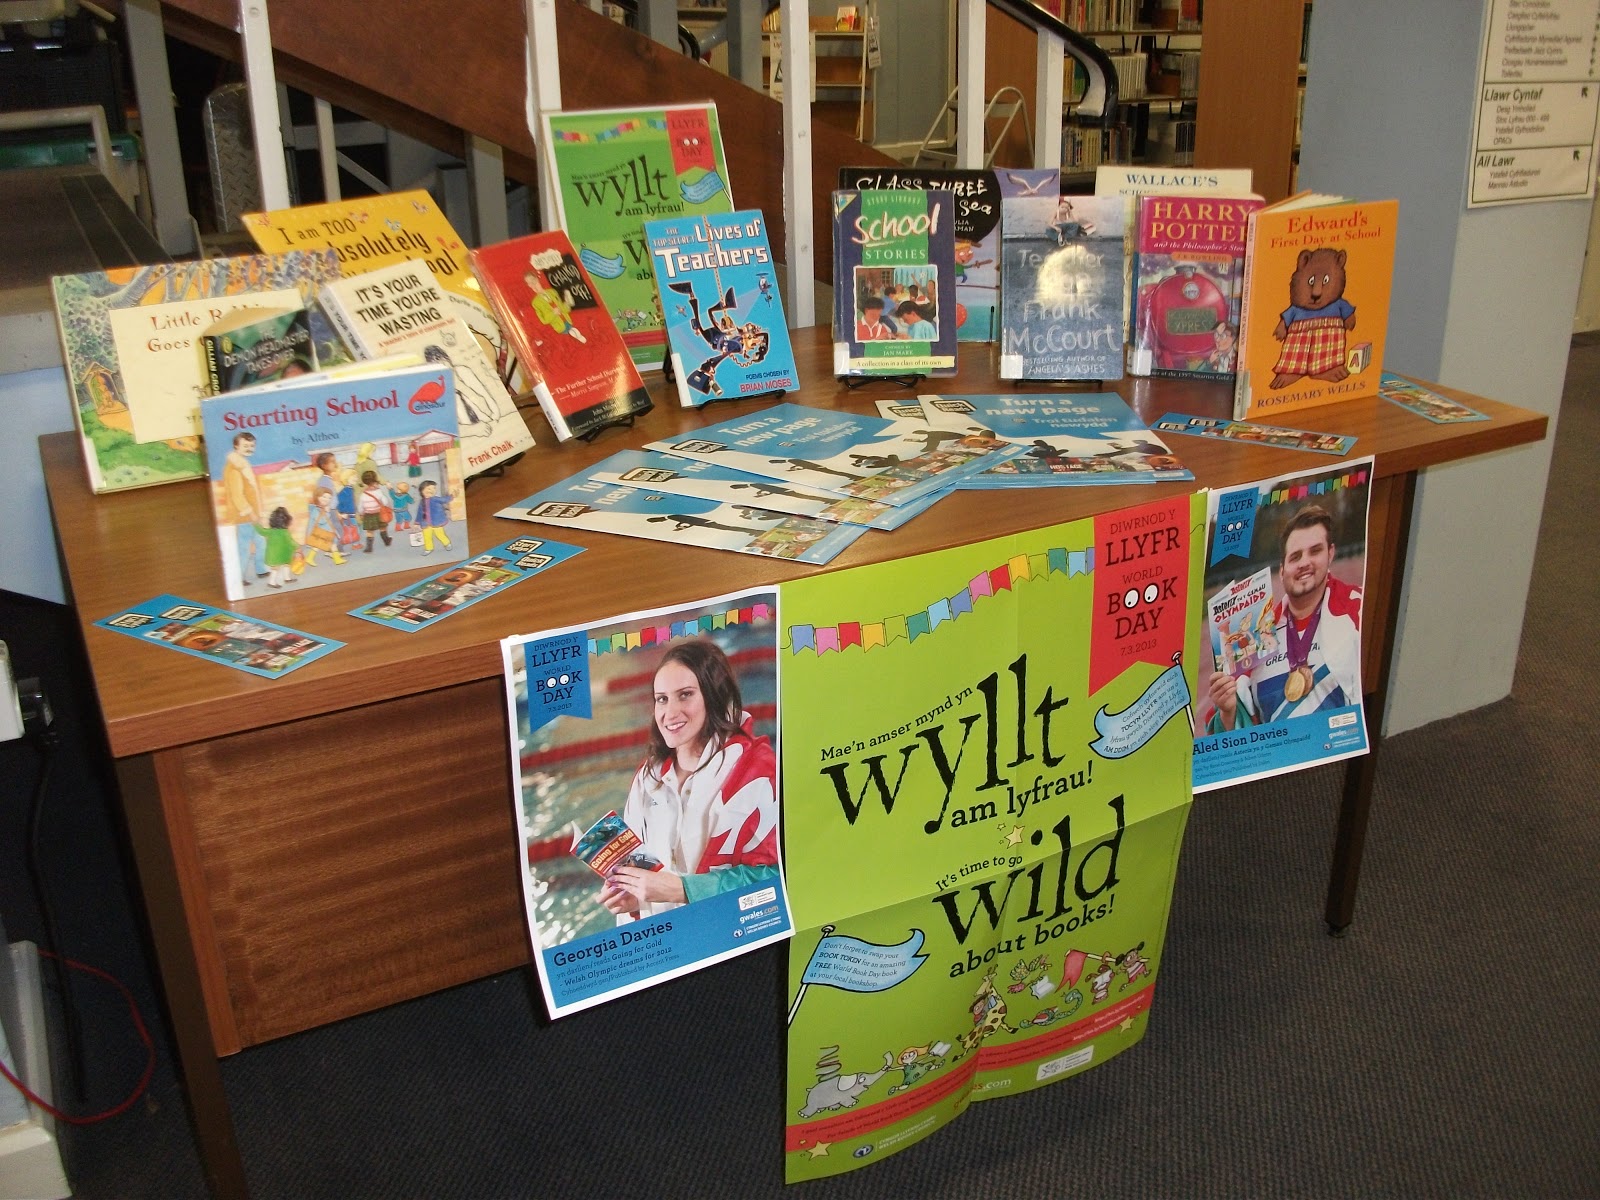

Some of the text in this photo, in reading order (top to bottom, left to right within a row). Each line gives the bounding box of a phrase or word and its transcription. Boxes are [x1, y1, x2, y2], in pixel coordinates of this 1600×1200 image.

[1484, 87, 1544, 103] Llawr Cyntaf
[1492, 155, 1515, 167] Lawr
[573, 154, 670, 216] wyllt
[1126, 174, 1219, 187] WALLACE'S
[625, 202, 685, 218] am lyfrau!
[959, 200, 992, 217] Sea
[1153, 201, 1253, 222] HARRY
[278, 217, 357, 245] I am TOO
[694, 219, 761, 243] Lives of
[851, 202, 941, 244] School
[1287, 210, 1368, 234] Edward's
[327, 230, 431, 263] bsolutely
[1182, 243, 1227, 251] Philosopher's
[1229, 244, 1245, 252] Ston
[1270, 227, 1381, 248] First Day at School
[654, 242, 769, 279] Teachers
[865, 250, 926, 261] STORIES
[355, 285, 384, 304] IT'S
[383, 274, 422, 295] YOUR
[356, 287, 441, 323] TIME YOU'RE
[1023, 300, 1102, 322] Frank
[150, 311, 201, 331] Little
[379, 307, 443, 336] WASTING
[148, 337, 191, 353] Goes
[1009, 324, 1120, 354] McCourt
[206, 340, 217, 372] GILLIAN
[1349, 353, 1360, 368] A
[762, 371, 781, 379] CHOSEN
[1028, 363, 1105, 375] ANGELA'S ASHES
[555, 372, 604, 395] The Further School
[740, 379, 792, 393] BRIAN MOSES
[1257, 381, 1367, 408] ROSEMARY WELLS
[223, 390, 400, 431] Starting School
[986, 406, 1100, 416] new page
[1000, 398, 1054, 406] Turn
[718, 416, 783, 436] Turn a
[734, 431, 778, 447] new
[773, 416, 822, 435] page
[292, 431, 340, 446] by Althea
[468, 441, 514, 467] Frank Chalk
[1222, 498, 1254, 514] LLYFR
[1110, 509, 1177, 535] DIWRNOD Y
[1220, 519, 1250, 535] BOOK
[1105, 526, 1181, 567] LLYFR
[1222, 531, 1243, 544] DAY
[1122, 566, 1163, 585] WORLD
[1106, 576, 1177, 615] BOOK
[1214, 591, 1266, 623] OLYMPAIDD
[1114, 607, 1164, 640] DAY
[534, 637, 572, 651] DIWRNOD
[1120, 638, 1157, 657] 7.3.2013
[532, 645, 582, 667] LLYFR
[1265, 652, 1288, 667] GREA
[536, 670, 582, 692] BOOK
[544, 664, 571, 676] WORLD
[543, 686, 574, 704] DAY
[820, 687, 974, 763] Mae'n amser mynd yn
[1121, 715, 1141, 733] TOCYN
[820, 653, 1069, 835] wyllt
[1103, 745, 1114, 753] AM
[1193, 728, 1288, 756] Aled Sion Davies
[950, 760, 1095, 829] am lyfrau!
[591, 848, 610, 869] Going
[610, 841, 620, 851] for
[618, 829, 634, 844] Gold
[931, 793, 1126, 945] wild
[935, 854, 1024, 891] It's time to go
[740, 905, 779, 924] gwales.com
[553, 921, 673, 967] Georgia Davies
[949, 893, 1116, 978] about books!
[612, 949, 633, 961] Going
[634, 945, 645, 953] for
[646, 939, 662, 950] Gold
[818, 951, 839, 960] BOOK
[840, 954, 862, 964] TOKEN
[861, 958, 871, 967] for
[879, 960, 906, 968] amazing
[824, 942, 843, 950] Don't
[842, 942, 861, 955] forget
[868, 950, 883, 960] swap
[883, 953, 900, 961] your
[564, 947, 673, 986] Welsh Olympic dreams for 2012
[814, 961, 898, 979] FREE World Book Day book
[818, 973, 832, 981] your
[832, 973, 848, 983] local
